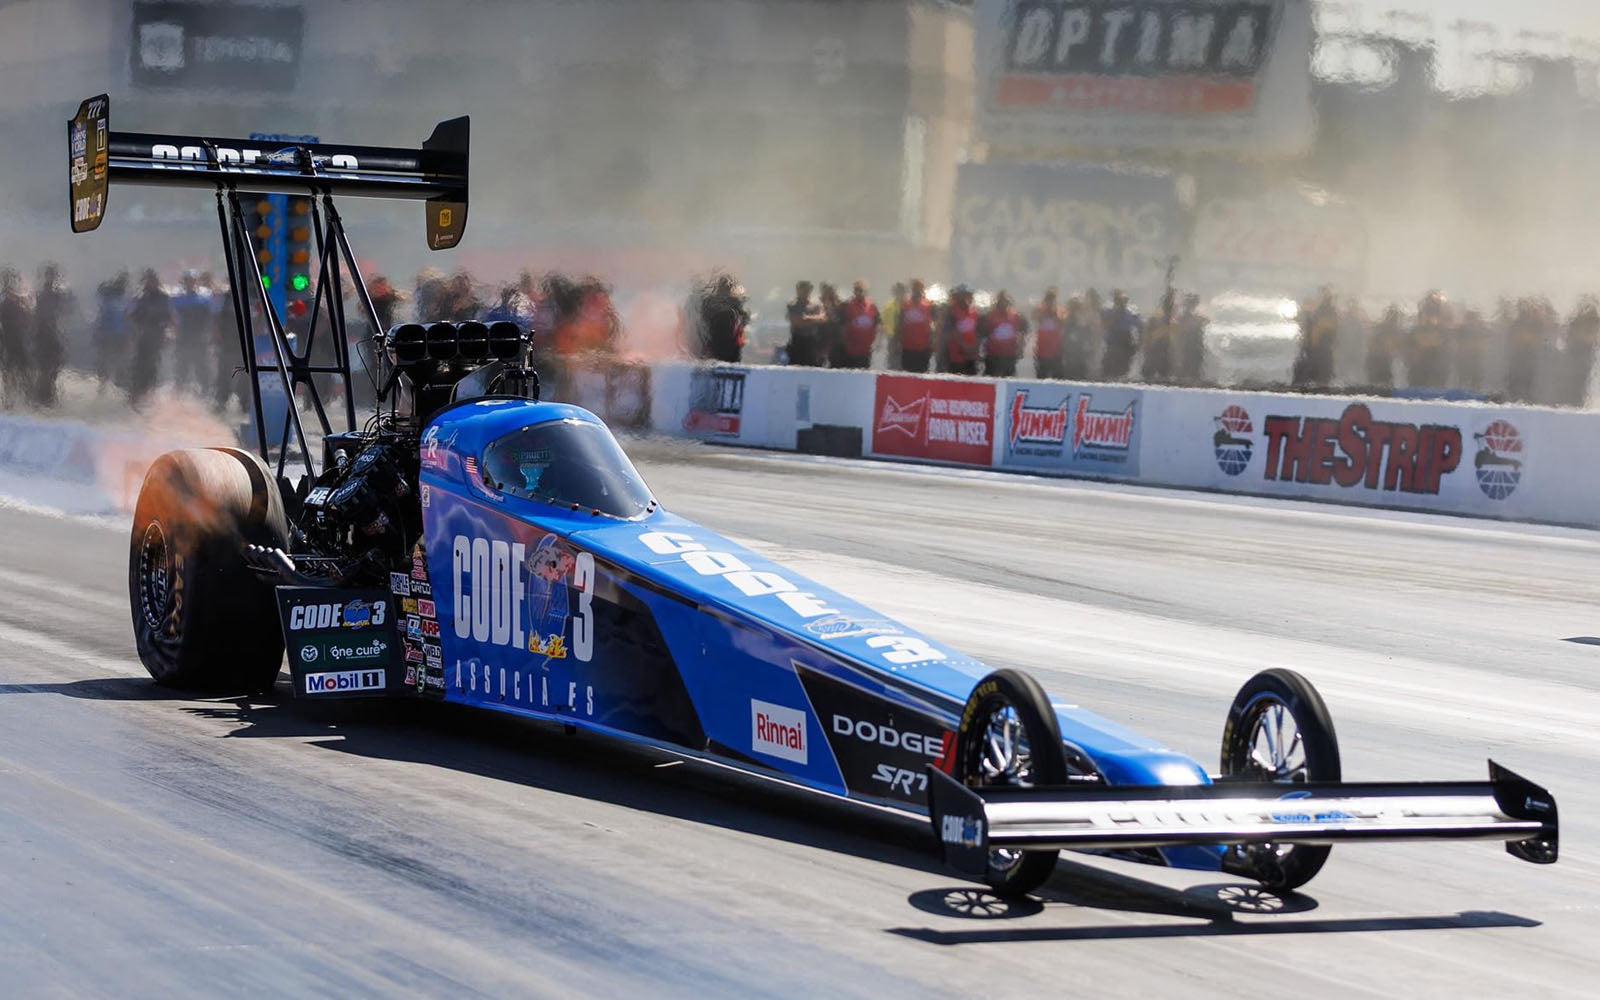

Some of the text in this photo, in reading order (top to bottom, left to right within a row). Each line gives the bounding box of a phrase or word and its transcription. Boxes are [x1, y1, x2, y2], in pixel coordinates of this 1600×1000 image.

[1012, 7, 1259, 69] OPTIMA
[289, 602, 343, 631] CODE
[371, 600, 387, 625] 3
[453, 535, 596, 662] CODE 3
[638, 531, 948, 664] CODE 3
[331, 644, 353, 658] one
[355, 642, 380, 656] cure
[308, 672, 359, 691] Mobil
[454, 659, 594, 715] ASSOCIAES
[756, 712, 804, 751] Rinnai
[832, 714, 946, 758] DODGE
